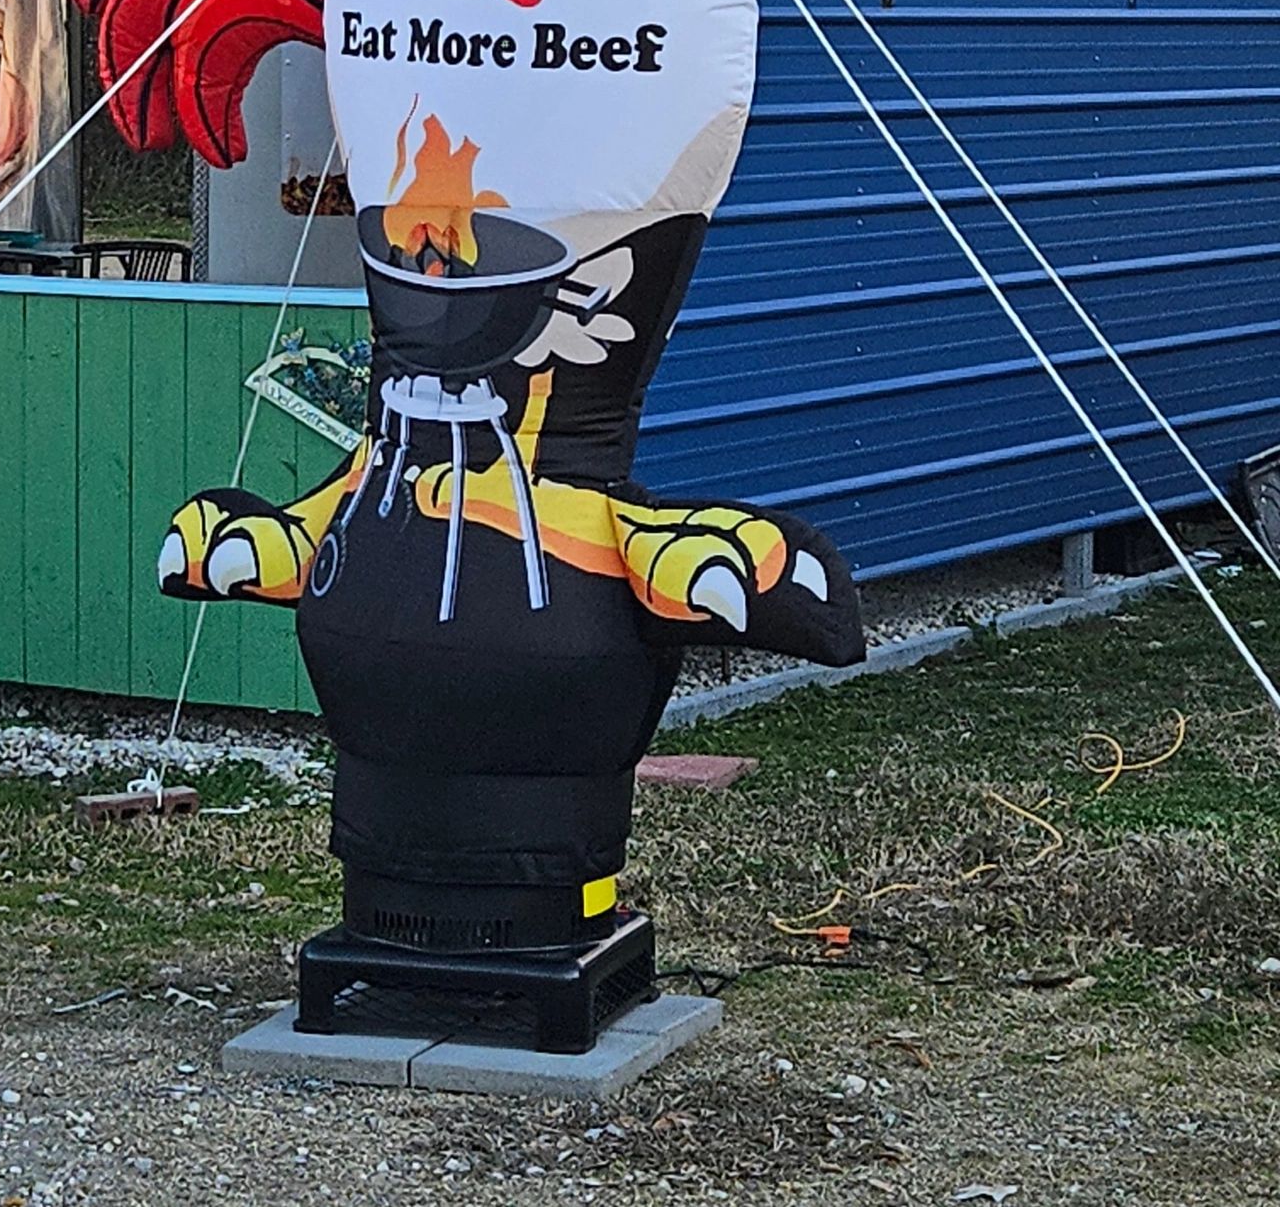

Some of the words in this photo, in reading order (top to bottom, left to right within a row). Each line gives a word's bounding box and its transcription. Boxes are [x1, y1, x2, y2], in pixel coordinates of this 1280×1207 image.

[341, 11, 396, 62] Eat
[407, 18, 517, 69] More
[530, 23, 668, 73] Beef
